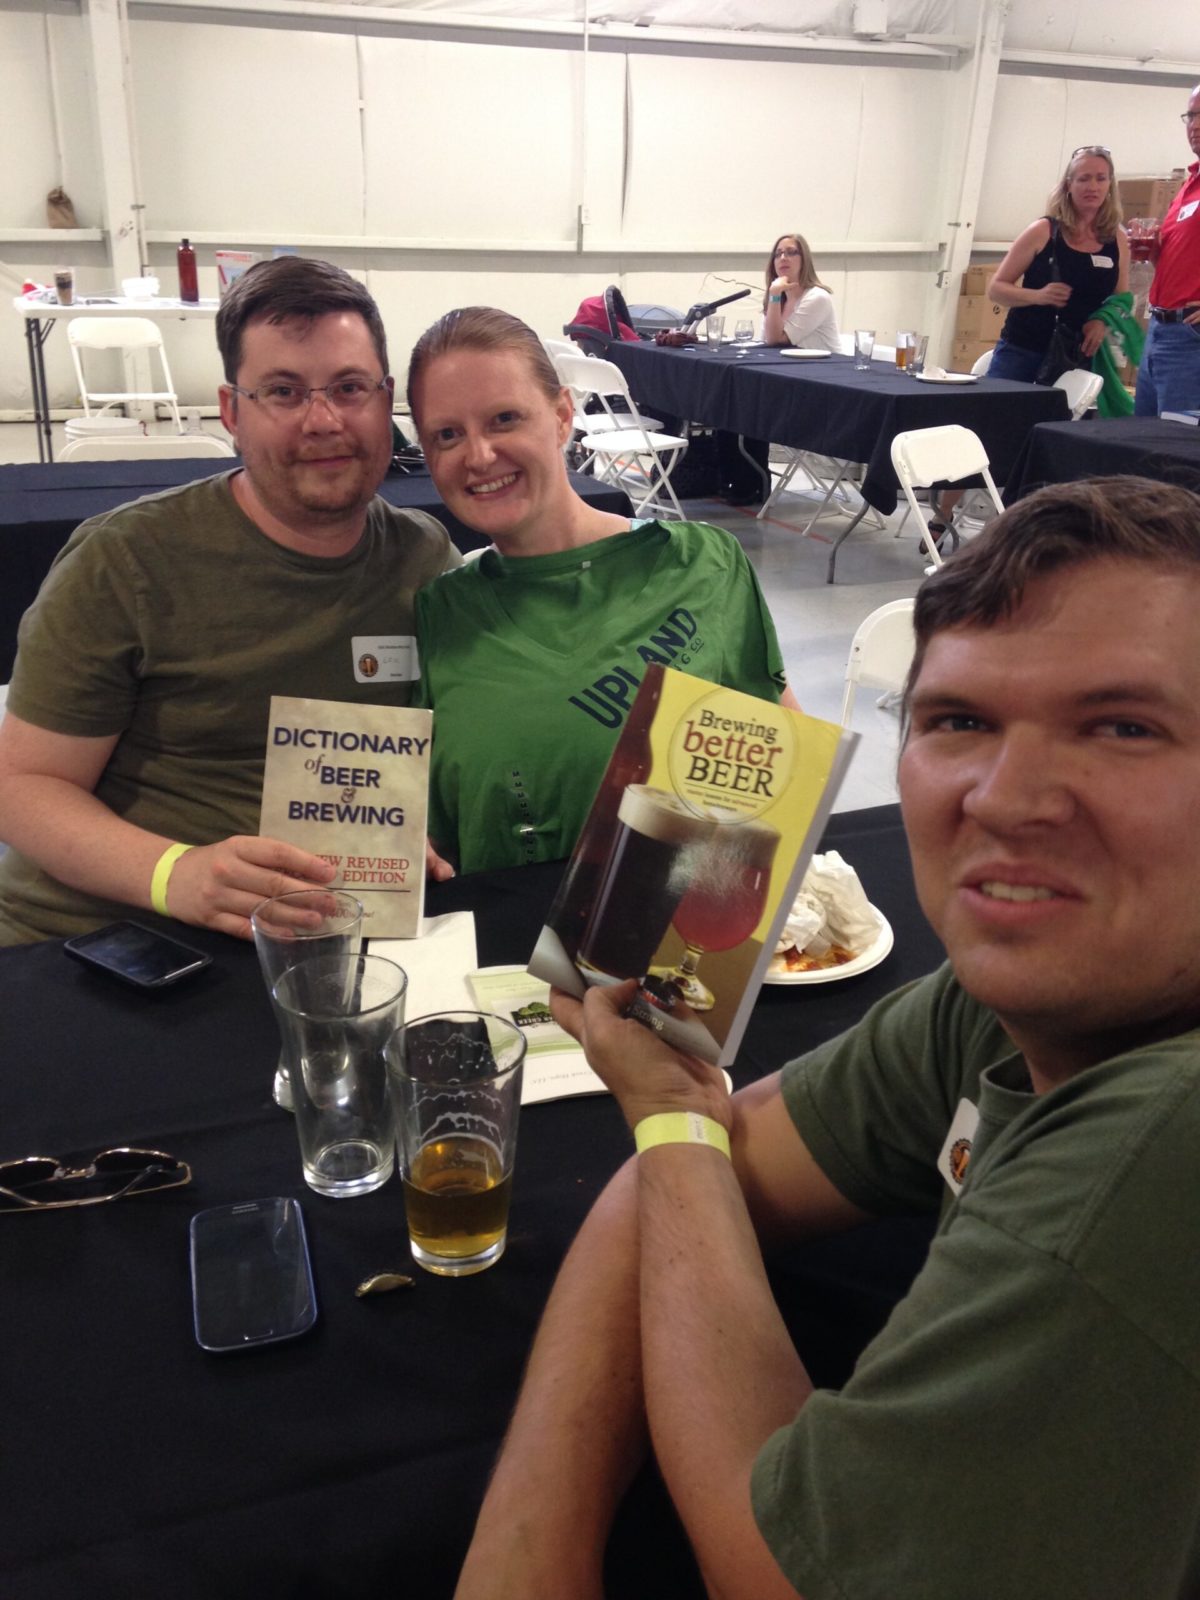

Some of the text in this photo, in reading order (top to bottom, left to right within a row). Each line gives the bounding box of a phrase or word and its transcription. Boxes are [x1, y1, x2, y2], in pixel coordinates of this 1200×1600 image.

[699, 709, 779, 744] Brewing
[273, 727, 429, 755] DICTIONARY
[684, 720, 784, 768] better
[304, 754, 325, 773] of
[686, 755, 774, 797] BEER
[320, 766, 380, 787] BEER
[288, 801, 404, 826] BREWING
[315, 854, 409, 870] EW REVISED
[342, 870, 405, 884] EDITION
